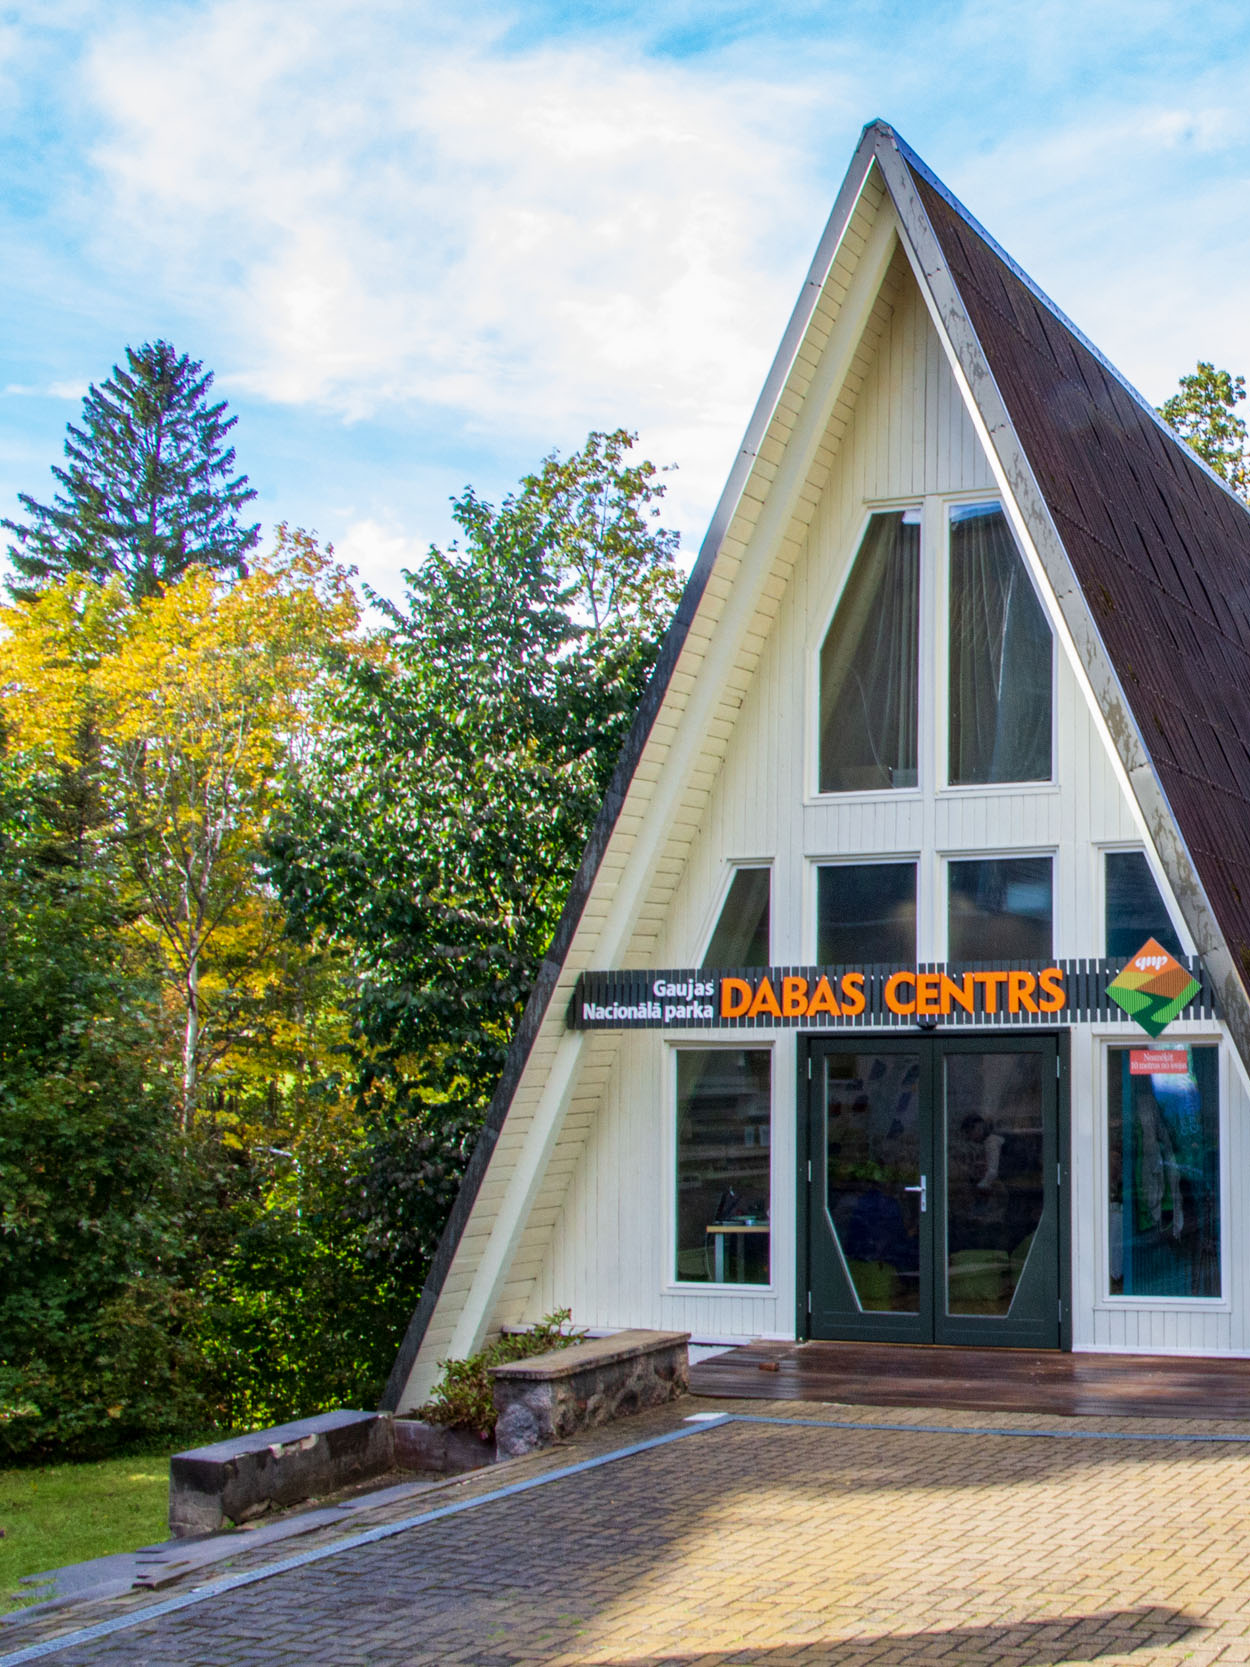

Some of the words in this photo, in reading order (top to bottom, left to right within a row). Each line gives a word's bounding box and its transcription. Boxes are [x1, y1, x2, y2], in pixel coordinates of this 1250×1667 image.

[652, 978, 715, 1001] Gaujas
[720, 972, 866, 1018] DABAS
[884, 967, 1066, 1016] CENTRS
[583, 1001, 661, 1020] Nacionālā
[664, 1001, 714, 1022] parka
